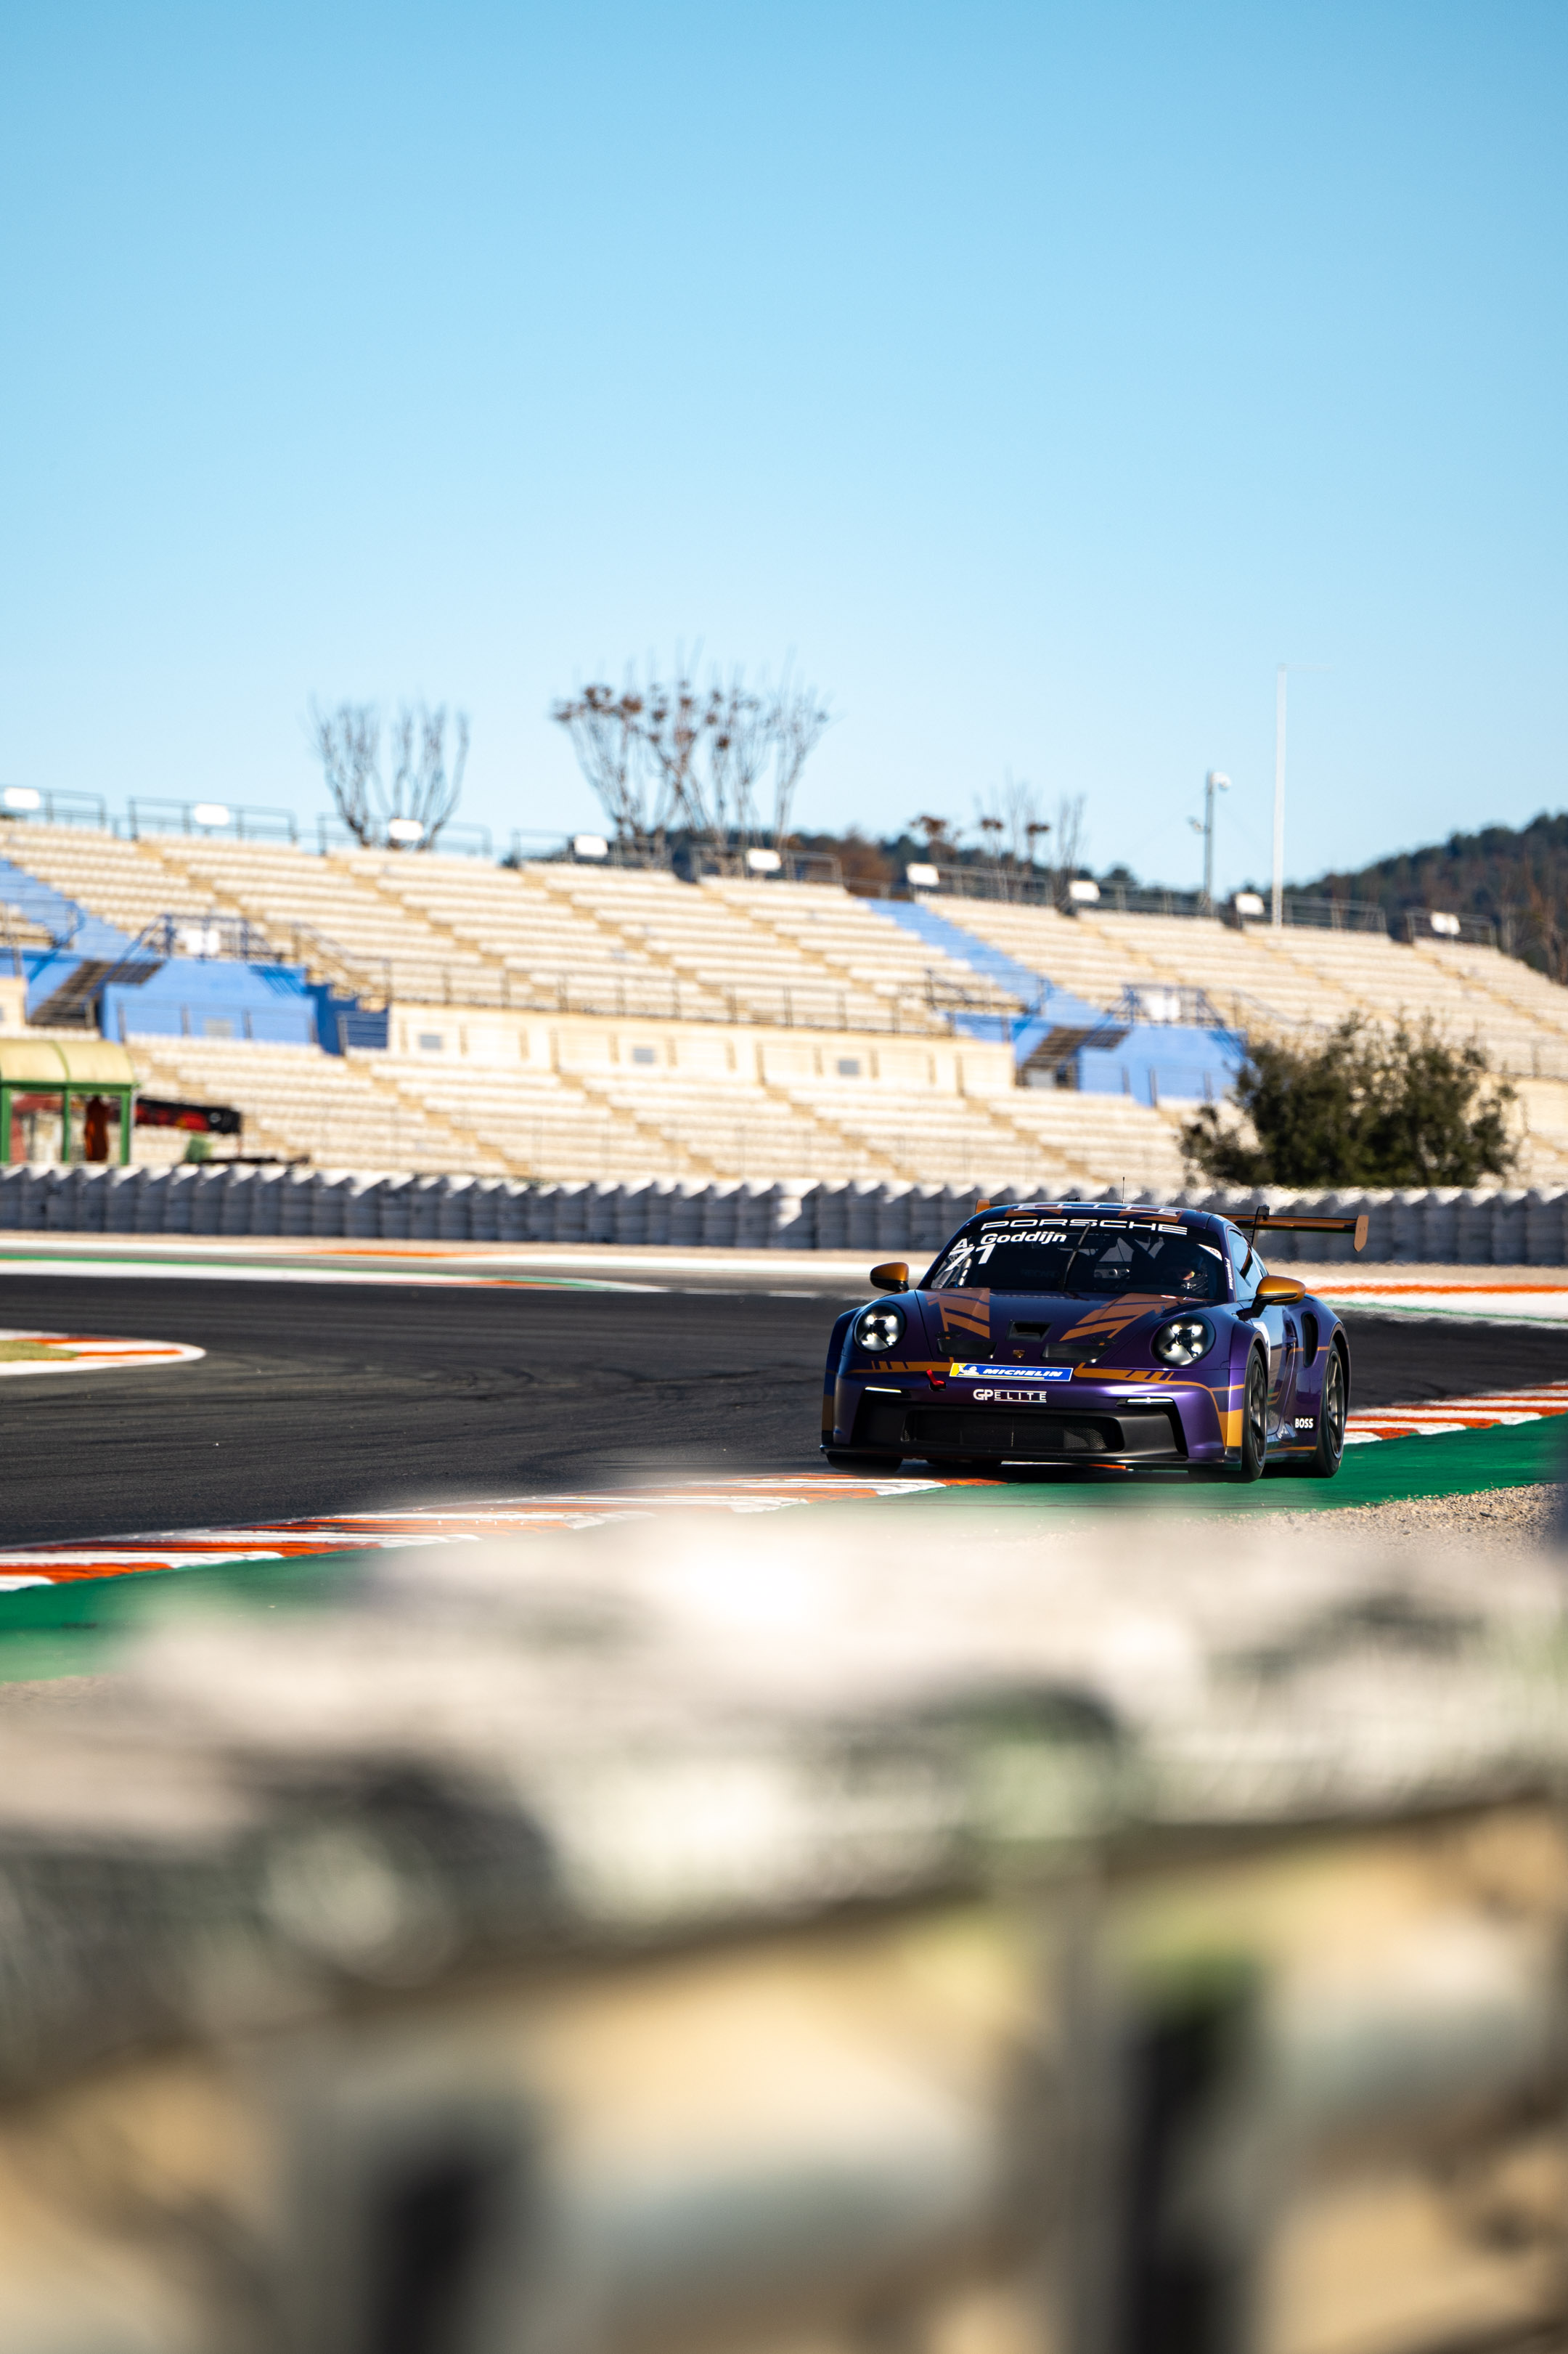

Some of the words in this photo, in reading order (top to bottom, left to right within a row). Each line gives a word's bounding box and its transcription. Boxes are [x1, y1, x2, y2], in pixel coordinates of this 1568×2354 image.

[981, 1219, 1188, 1235] PORSCHE
[952, 1238, 974, 1250] A.
[981, 1231, 1066, 1244] Goddijn
[944, 1243, 996, 1271] 71
[1295, 1418, 1313, 1428] BOSS
